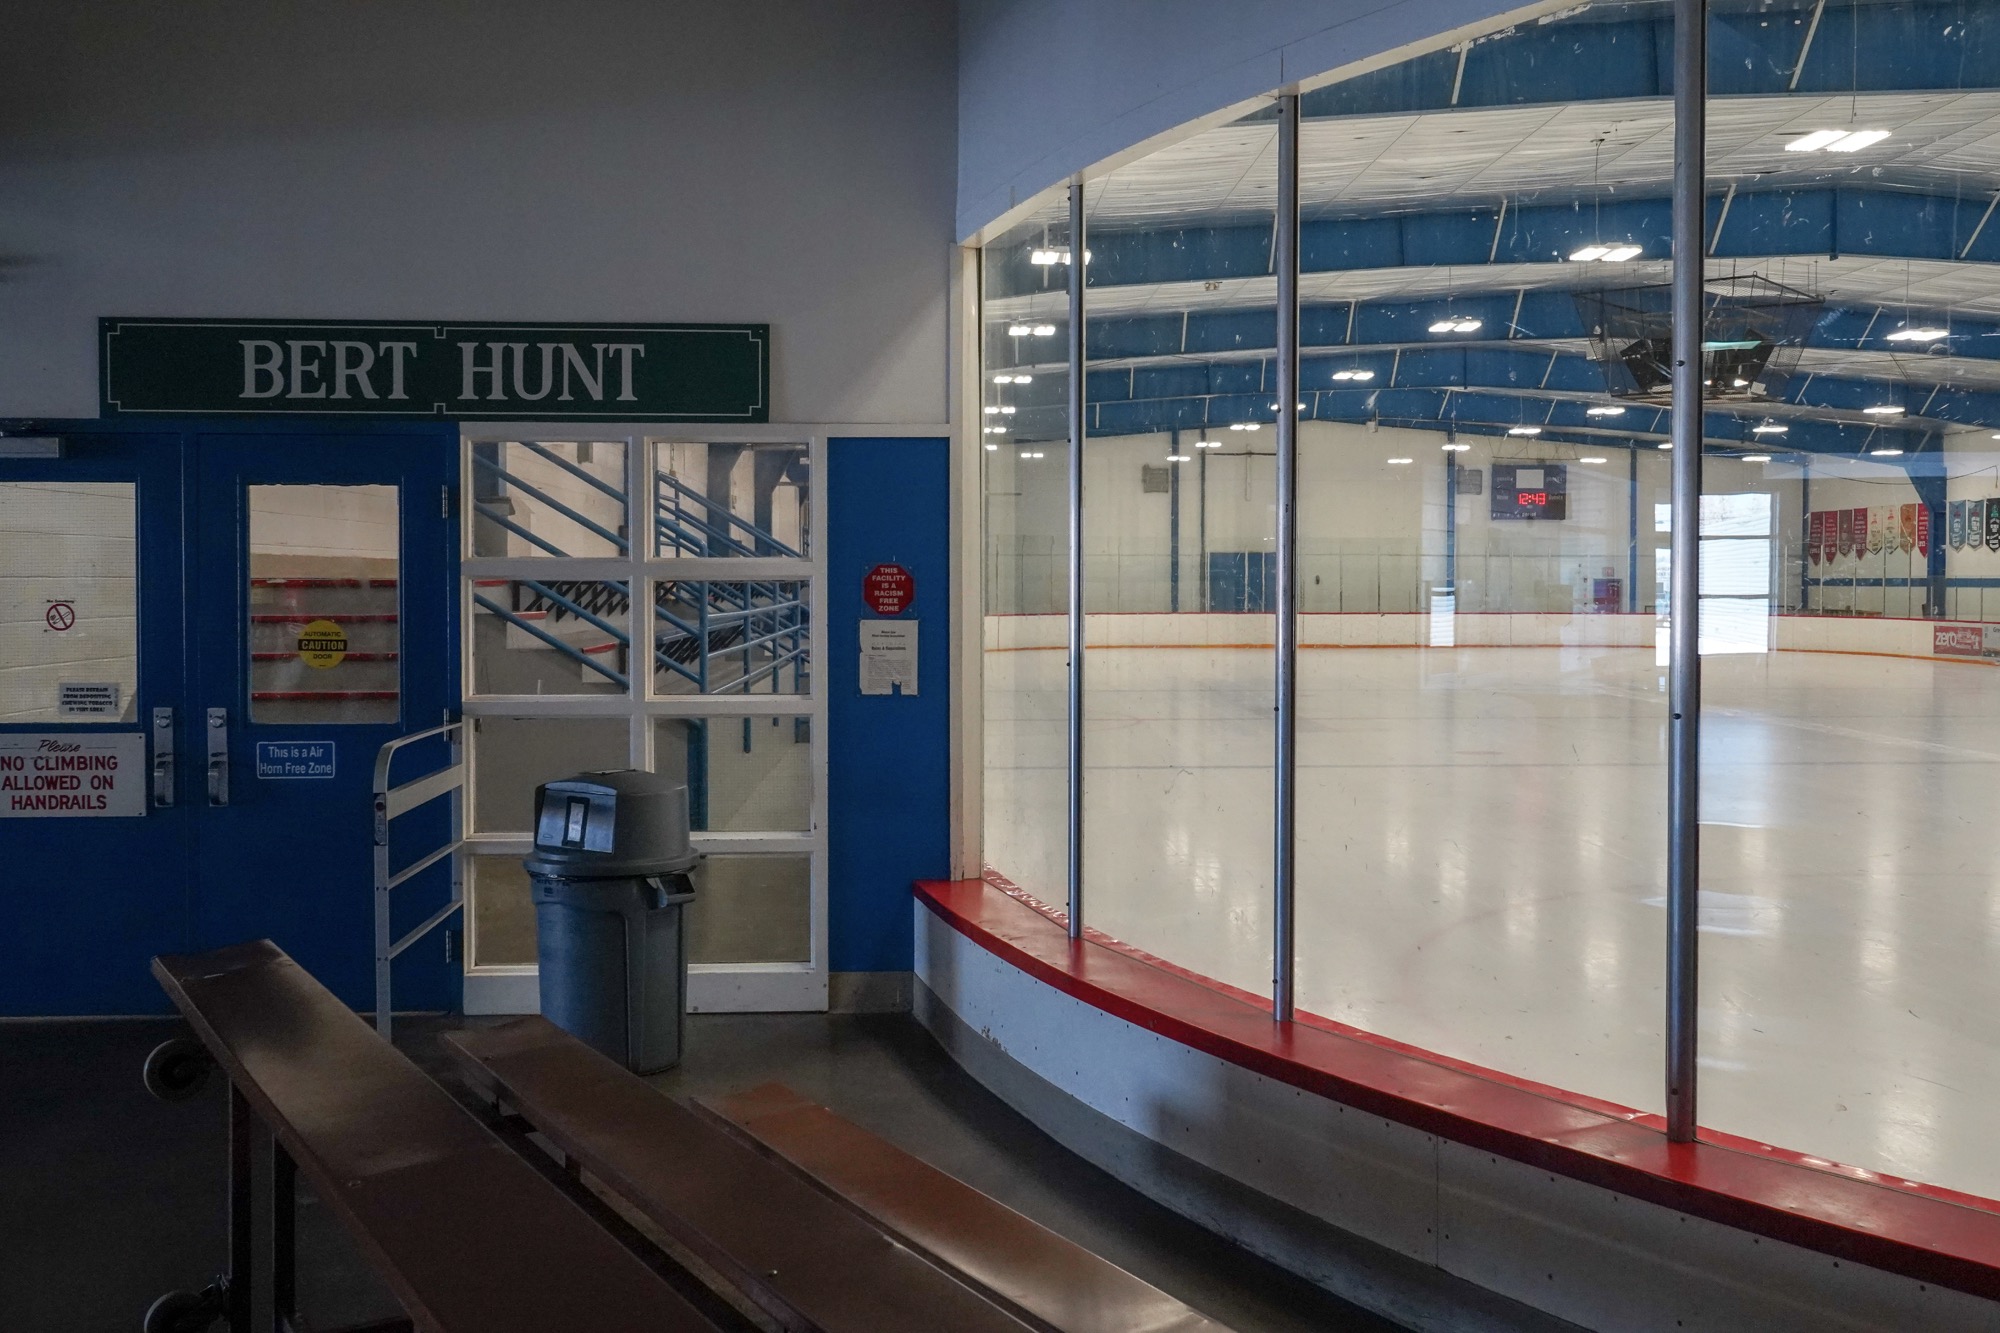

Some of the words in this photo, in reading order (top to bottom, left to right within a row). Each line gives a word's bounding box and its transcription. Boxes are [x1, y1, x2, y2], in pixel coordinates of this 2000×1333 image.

[238, 339, 417, 400] BERT
[456, 341, 645, 402] HUNT
[1518, 493, 1546, 505] 12:43
[301, 641, 345, 650] CAUTION
[1935, 632, 1957, 647] zero
[37, 739, 81, 753] Please
[268, 746, 289, 758] This
[291, 746, 300, 758] is
[301, 749, 308, 758] a
[309, 746, 324, 758] Air
[0, 755, 25, 771] NO
[33, 755, 118, 771] CLIMBING
[260, 762, 283, 774] Horn
[285, 762, 306, 774] Free
[308, 762, 332, 774] Zone
[1, 775, 81, 791] ALLOWED
[90, 775, 114, 790] ON
[11, 794, 107, 811] HANDRAILS
